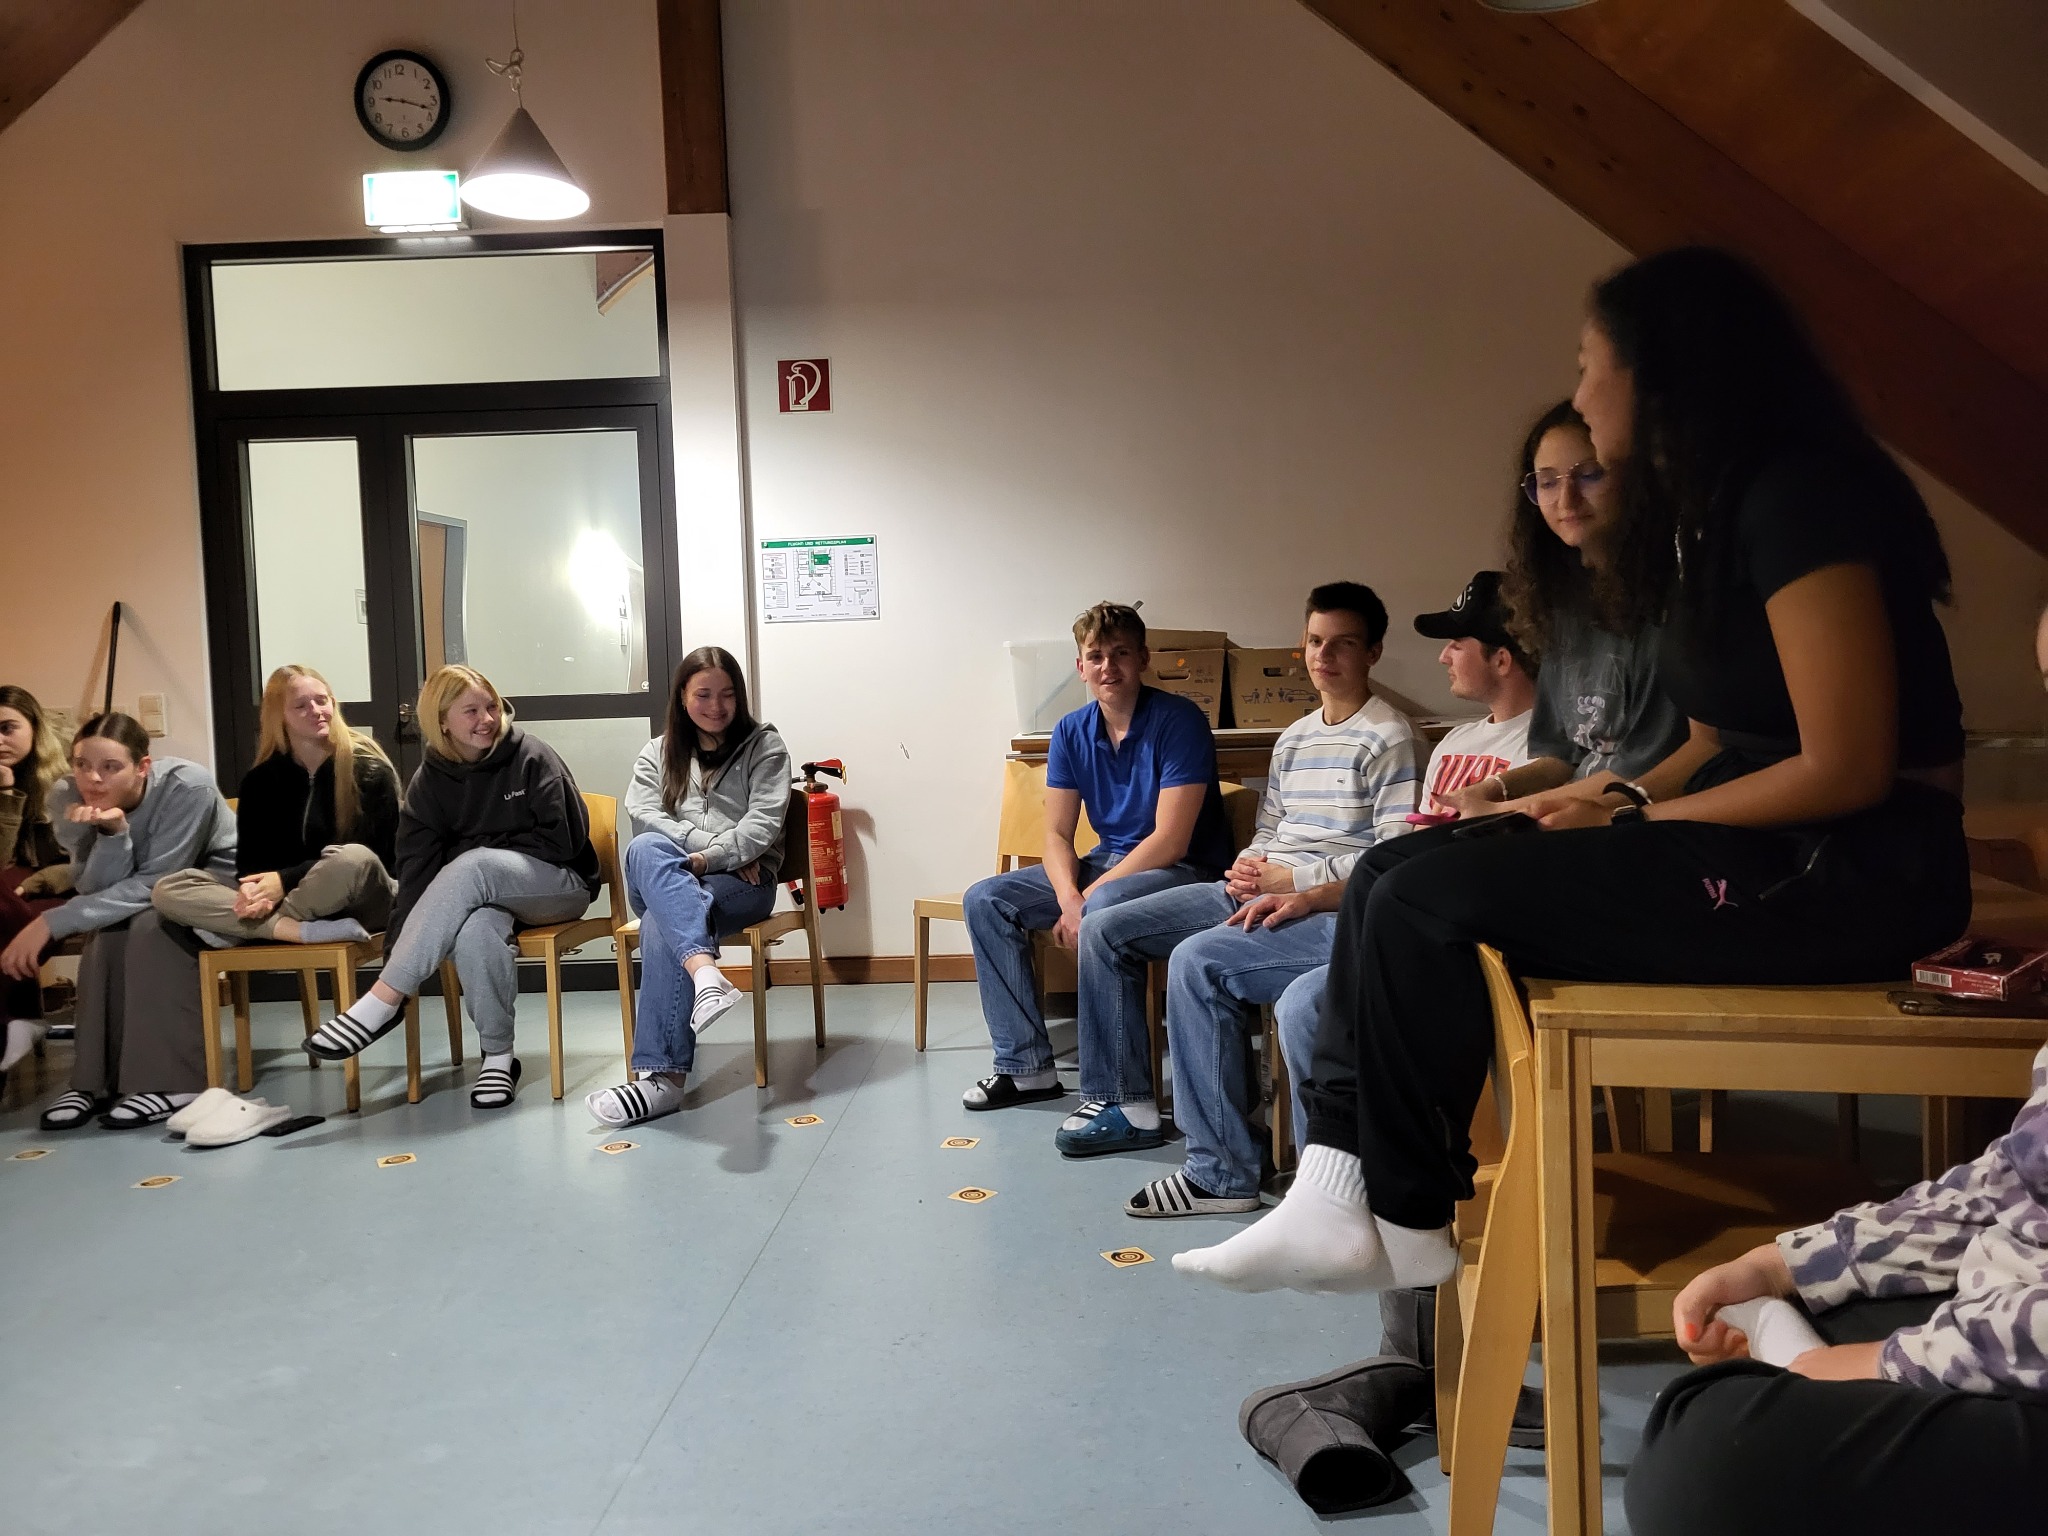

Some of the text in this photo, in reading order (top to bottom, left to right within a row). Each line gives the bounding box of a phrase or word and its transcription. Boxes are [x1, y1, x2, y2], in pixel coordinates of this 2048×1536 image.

[384, 69, 392, 79] 11
[394, 64, 405, 75] 12
[372, 79, 383, 90] 10
[422, 79, 431, 89] 2
[368, 97, 376, 107] 9
[429, 95, 438, 106] 3
[374, 113, 383, 123] 8
[426, 111, 433, 122] 4
[385, 123, 394, 134] 7
[401, 127, 410, 138] 6
[417, 123, 424, 134] 5
